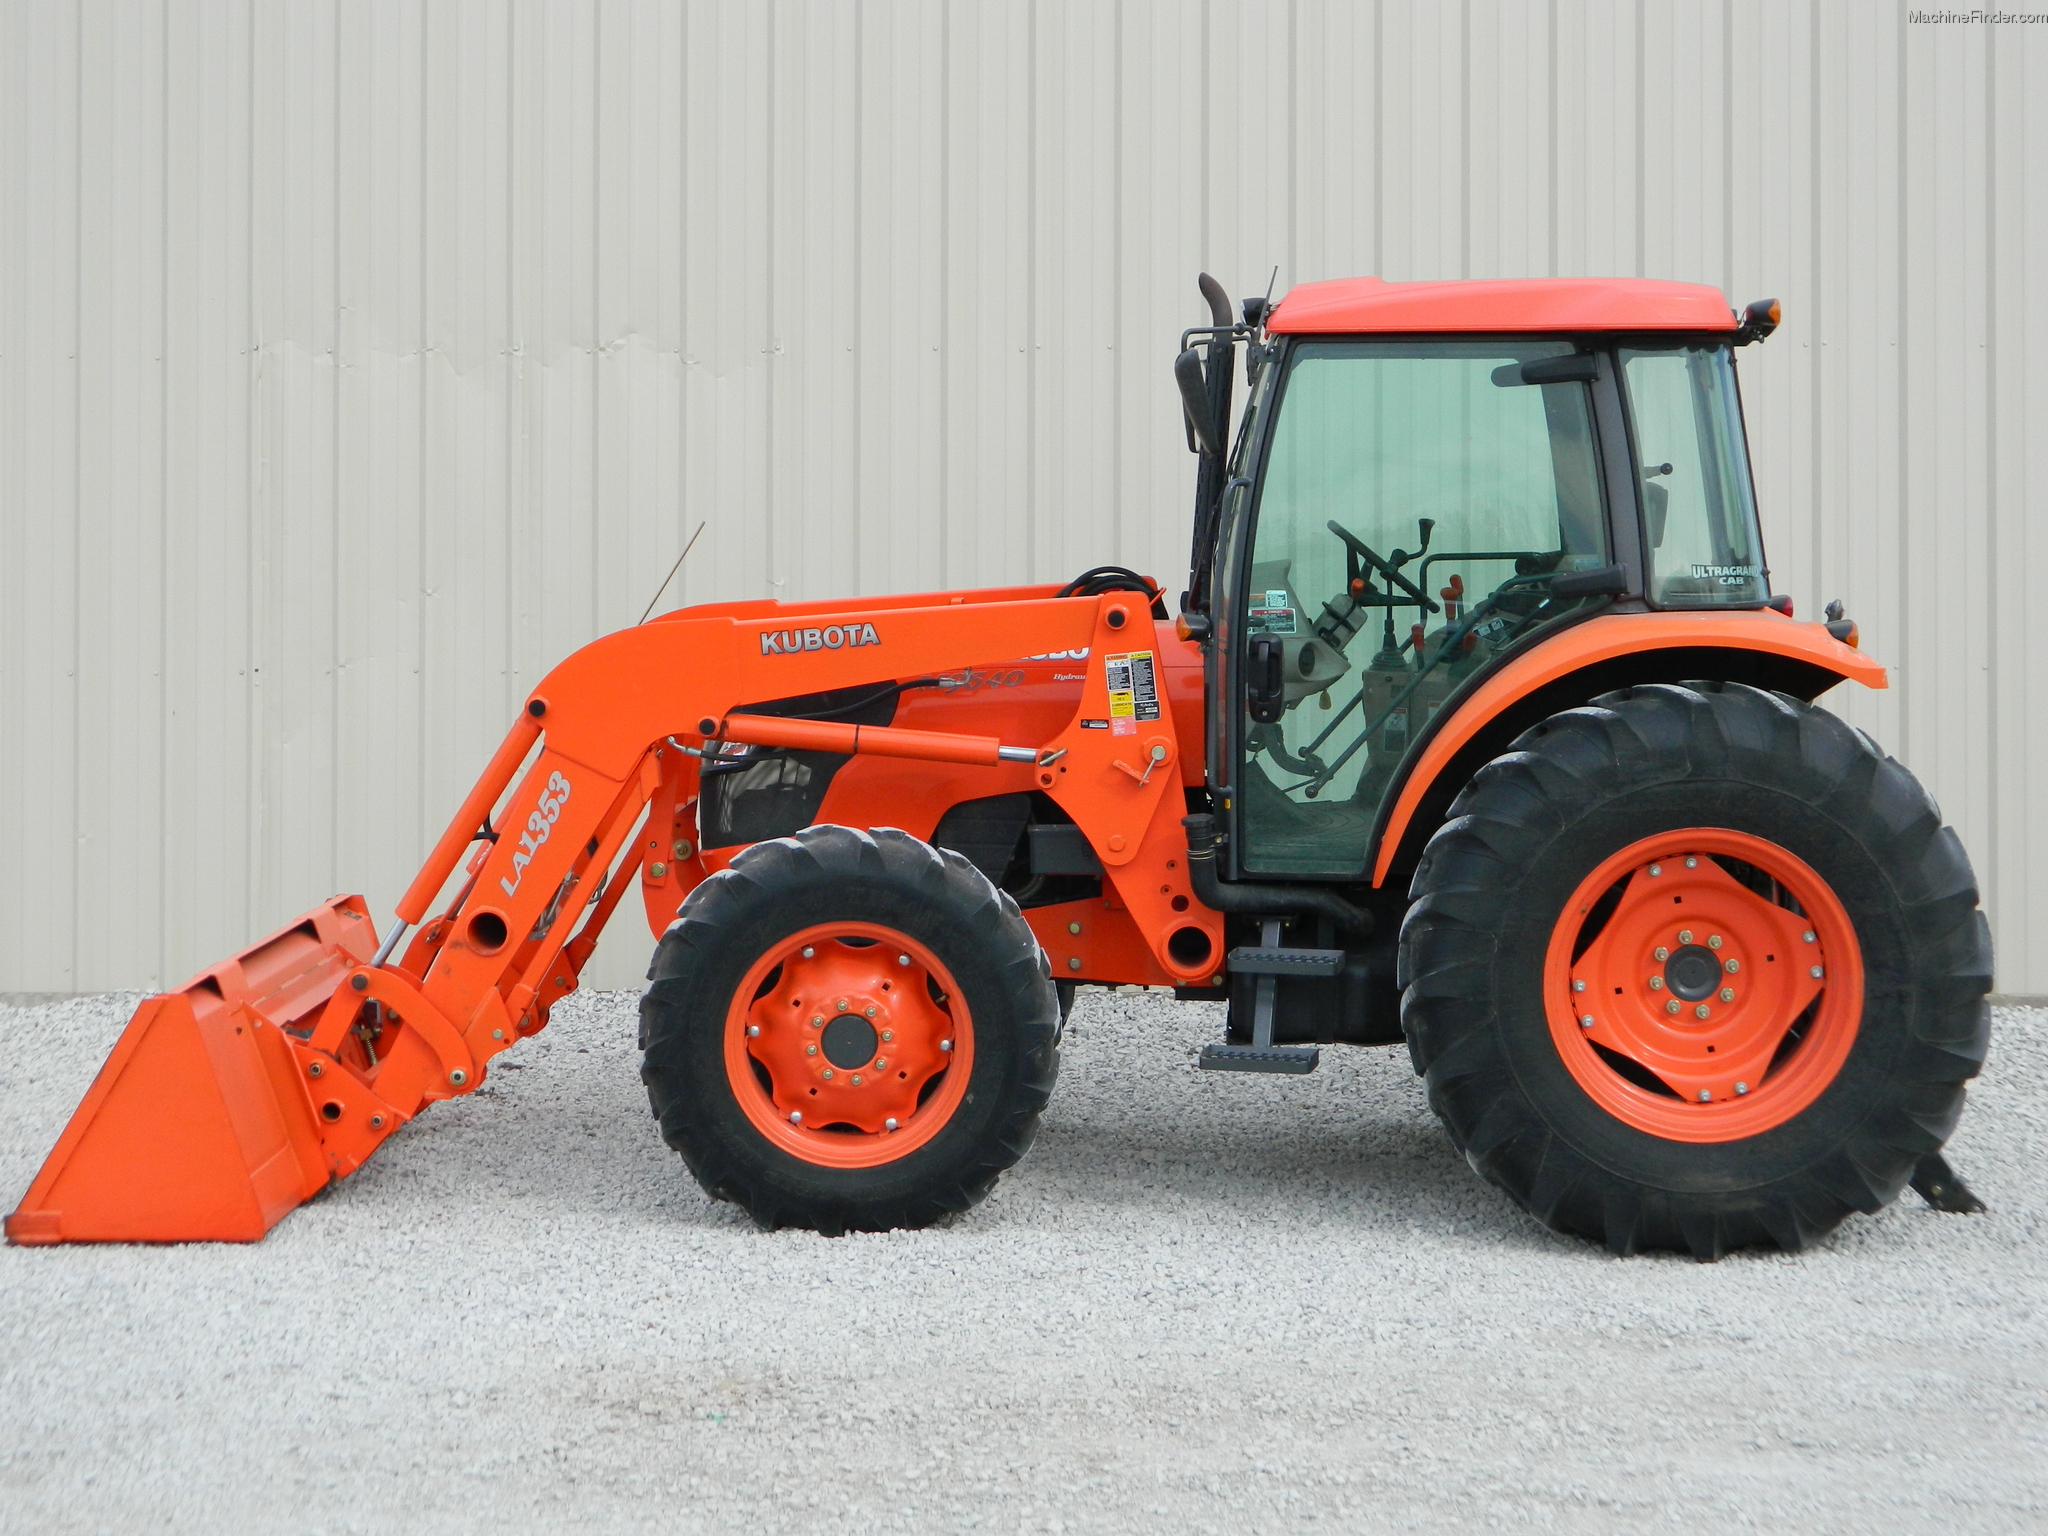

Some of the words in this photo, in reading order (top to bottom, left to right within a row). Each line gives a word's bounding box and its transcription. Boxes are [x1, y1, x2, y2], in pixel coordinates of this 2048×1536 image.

[1718, 576, 1744, 585] CAB
[760, 622, 881, 655] KUBOTA
[1053, 673, 1087, 681] Hydrau
[500, 770, 571, 897] LA1353
